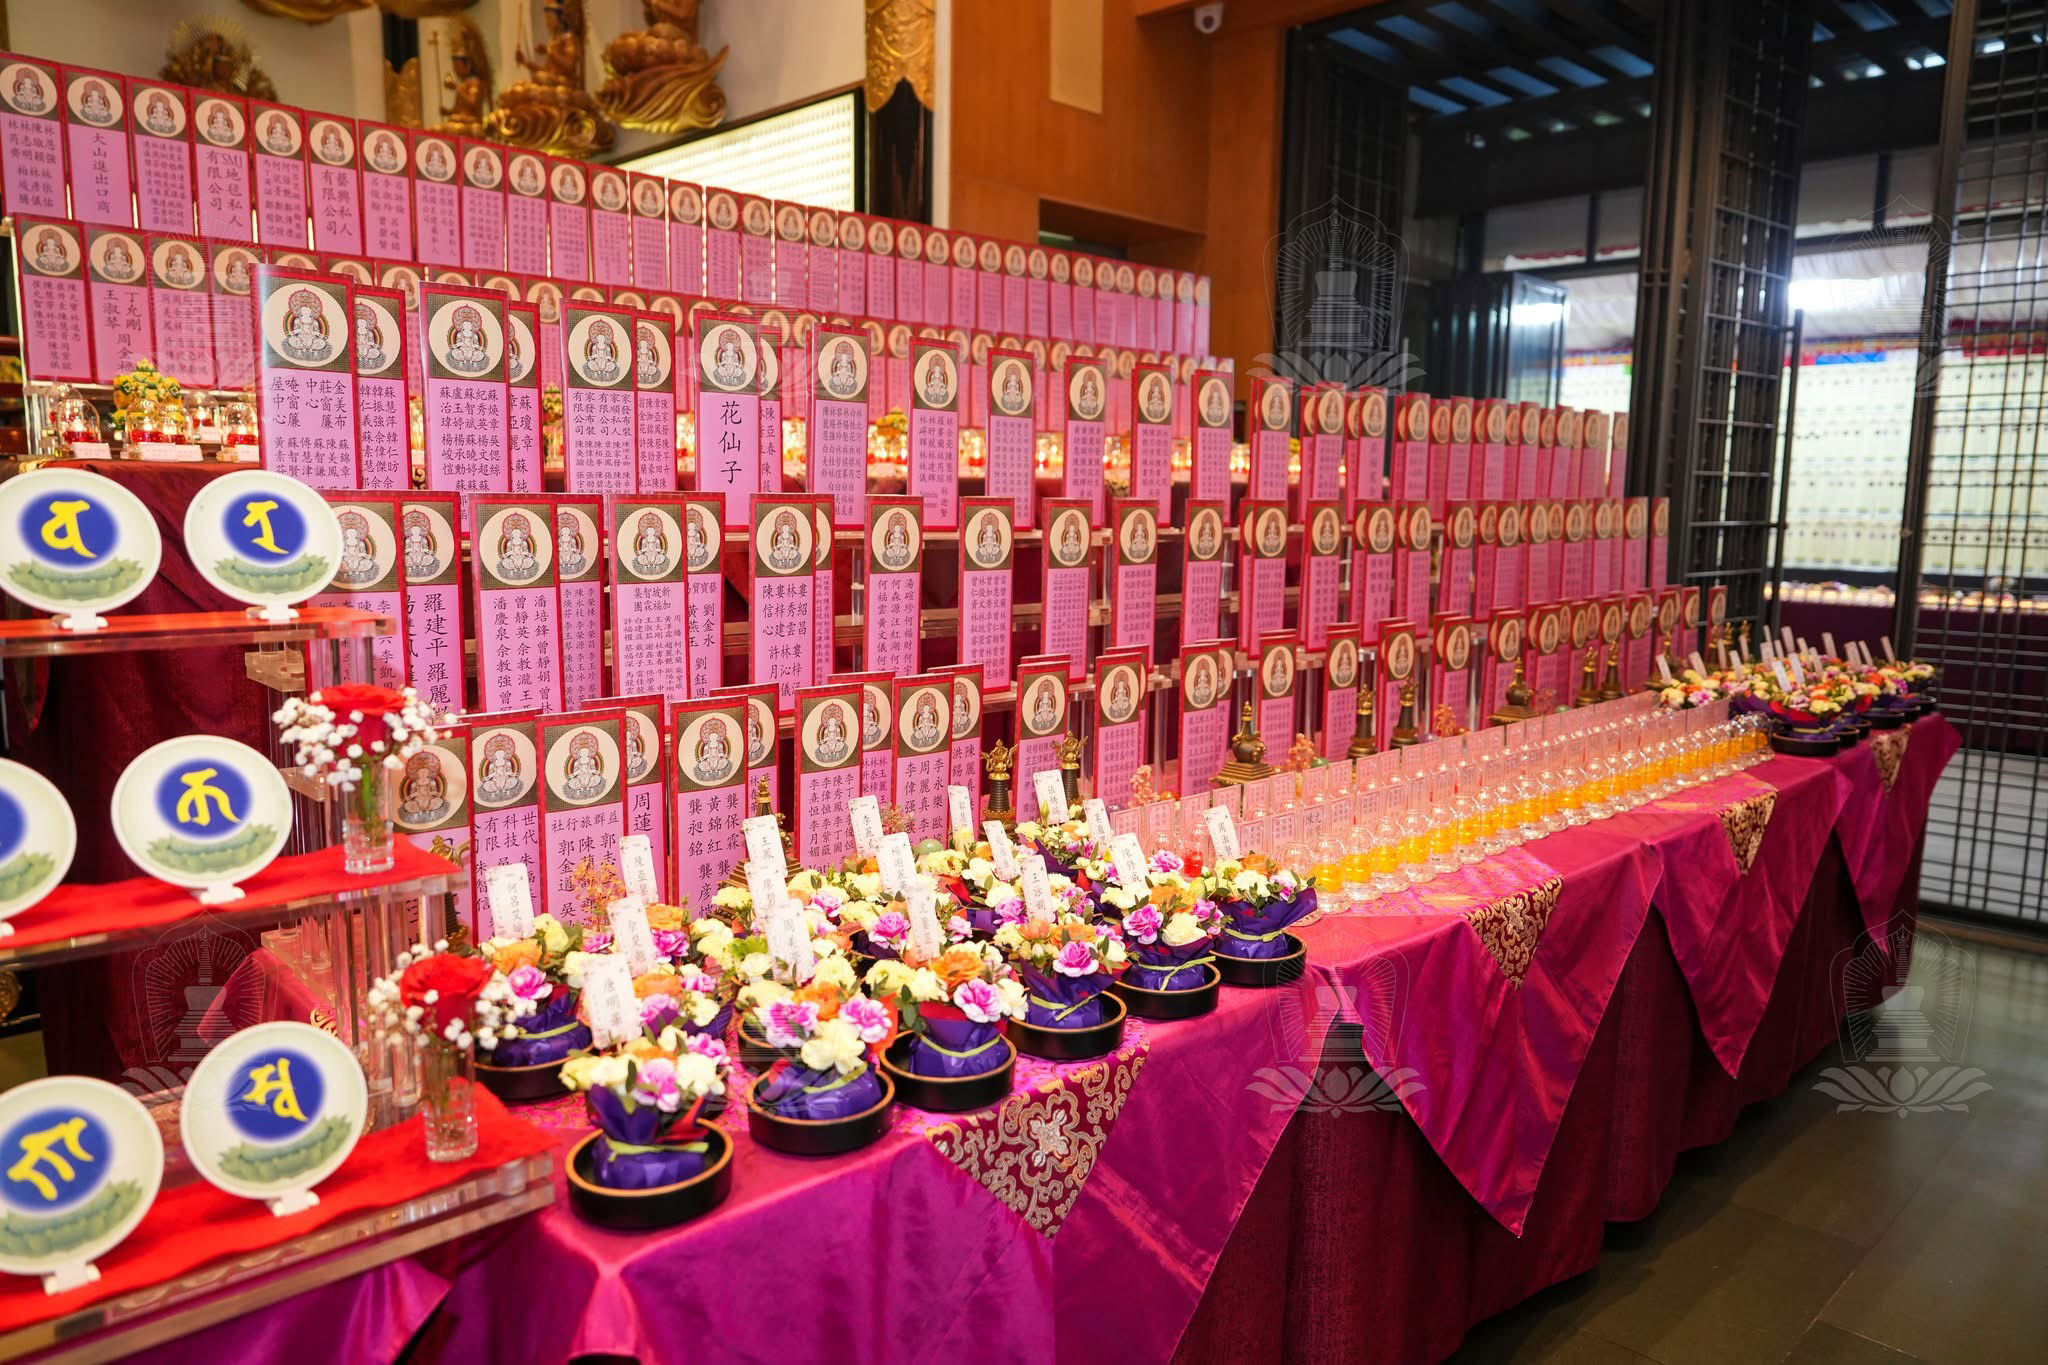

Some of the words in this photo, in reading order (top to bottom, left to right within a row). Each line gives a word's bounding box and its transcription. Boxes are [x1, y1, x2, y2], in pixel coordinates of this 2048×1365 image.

[206, 150, 223, 212] 有限公司
[321, 169, 338, 236] 有限公司
[305, 377, 318, 409] 中心
[476, 388, 488, 431] 紀秀英
[573, 391, 585, 436] 有限公司
[599, 392, 610, 436] 有限公司
[477, 434, 490, 476] 楊文超
[718, 400, 743, 485] 花仙子
[424, 592, 449, 658] 羅建平
[534, 594, 549, 638] 潘培鋒
[702, 602, 715, 648] 劉金水
[762, 583, 774, 636] 陳信心
[786, 583, 797, 637] 林秀雲
[933, 757, 944, 809] 李永樂
[503, 812, 520, 849] 科技
[521, 811, 538, 845] 世代
[632, 791, 654, 832] 周蓮
[484, 816, 500, 852] 有限
